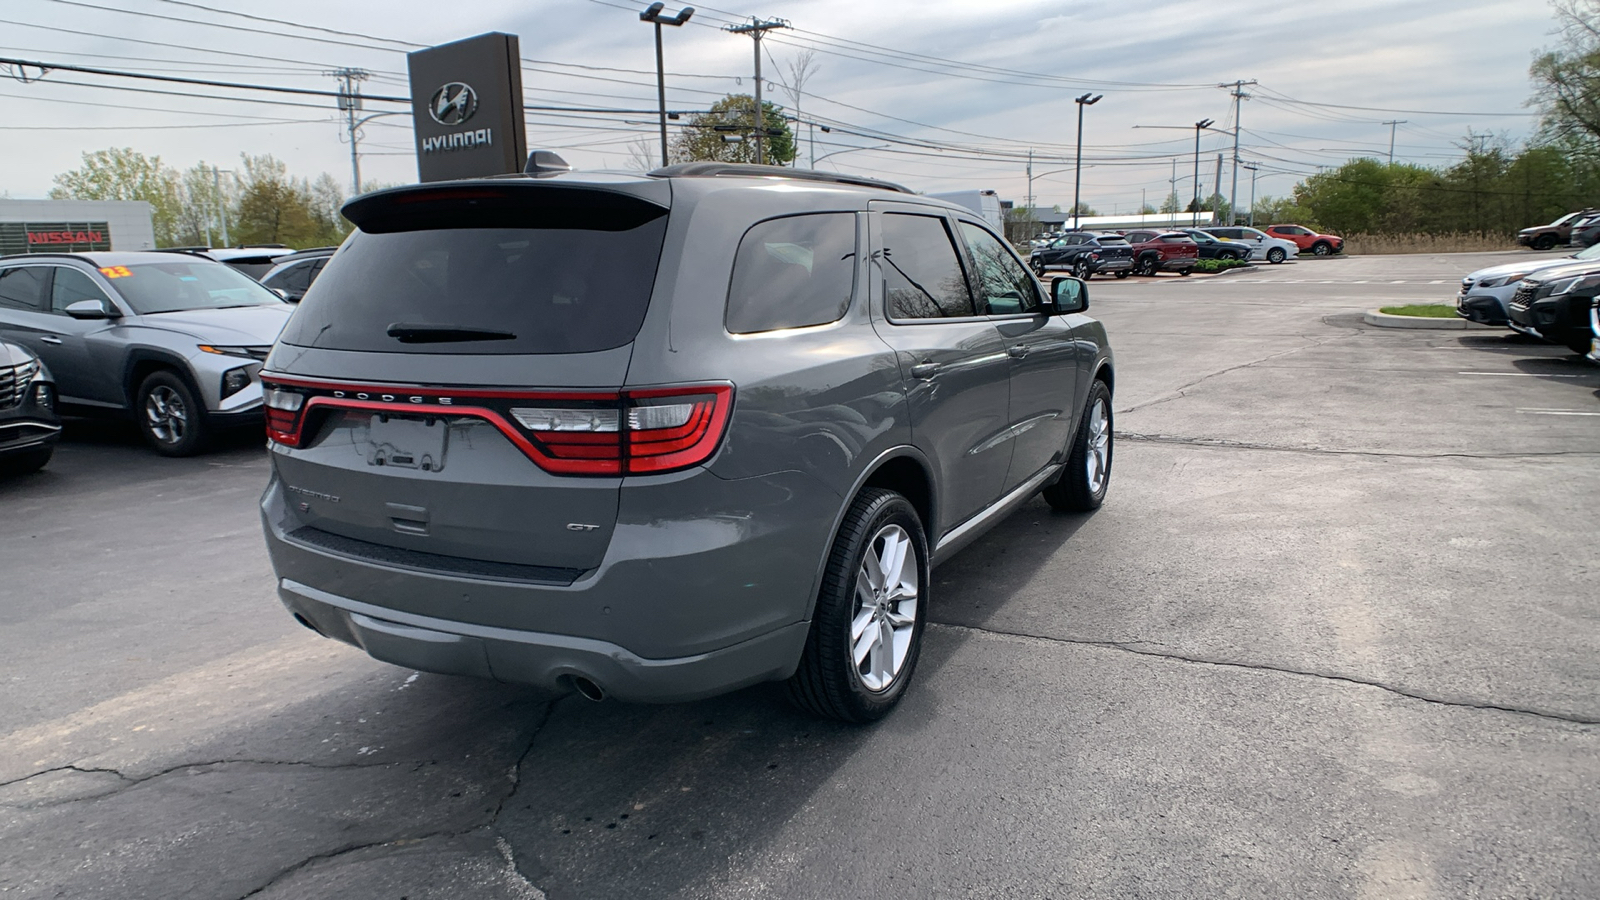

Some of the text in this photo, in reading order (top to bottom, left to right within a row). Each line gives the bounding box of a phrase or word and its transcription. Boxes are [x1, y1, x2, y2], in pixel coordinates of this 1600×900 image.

[422, 128, 492, 151] HYUNDAI
[27, 231, 102, 244] NISSAN
[99, 265, 133, 278] 23
[333, 390, 452, 405] DODGE
[566, 523, 600, 531] GT
